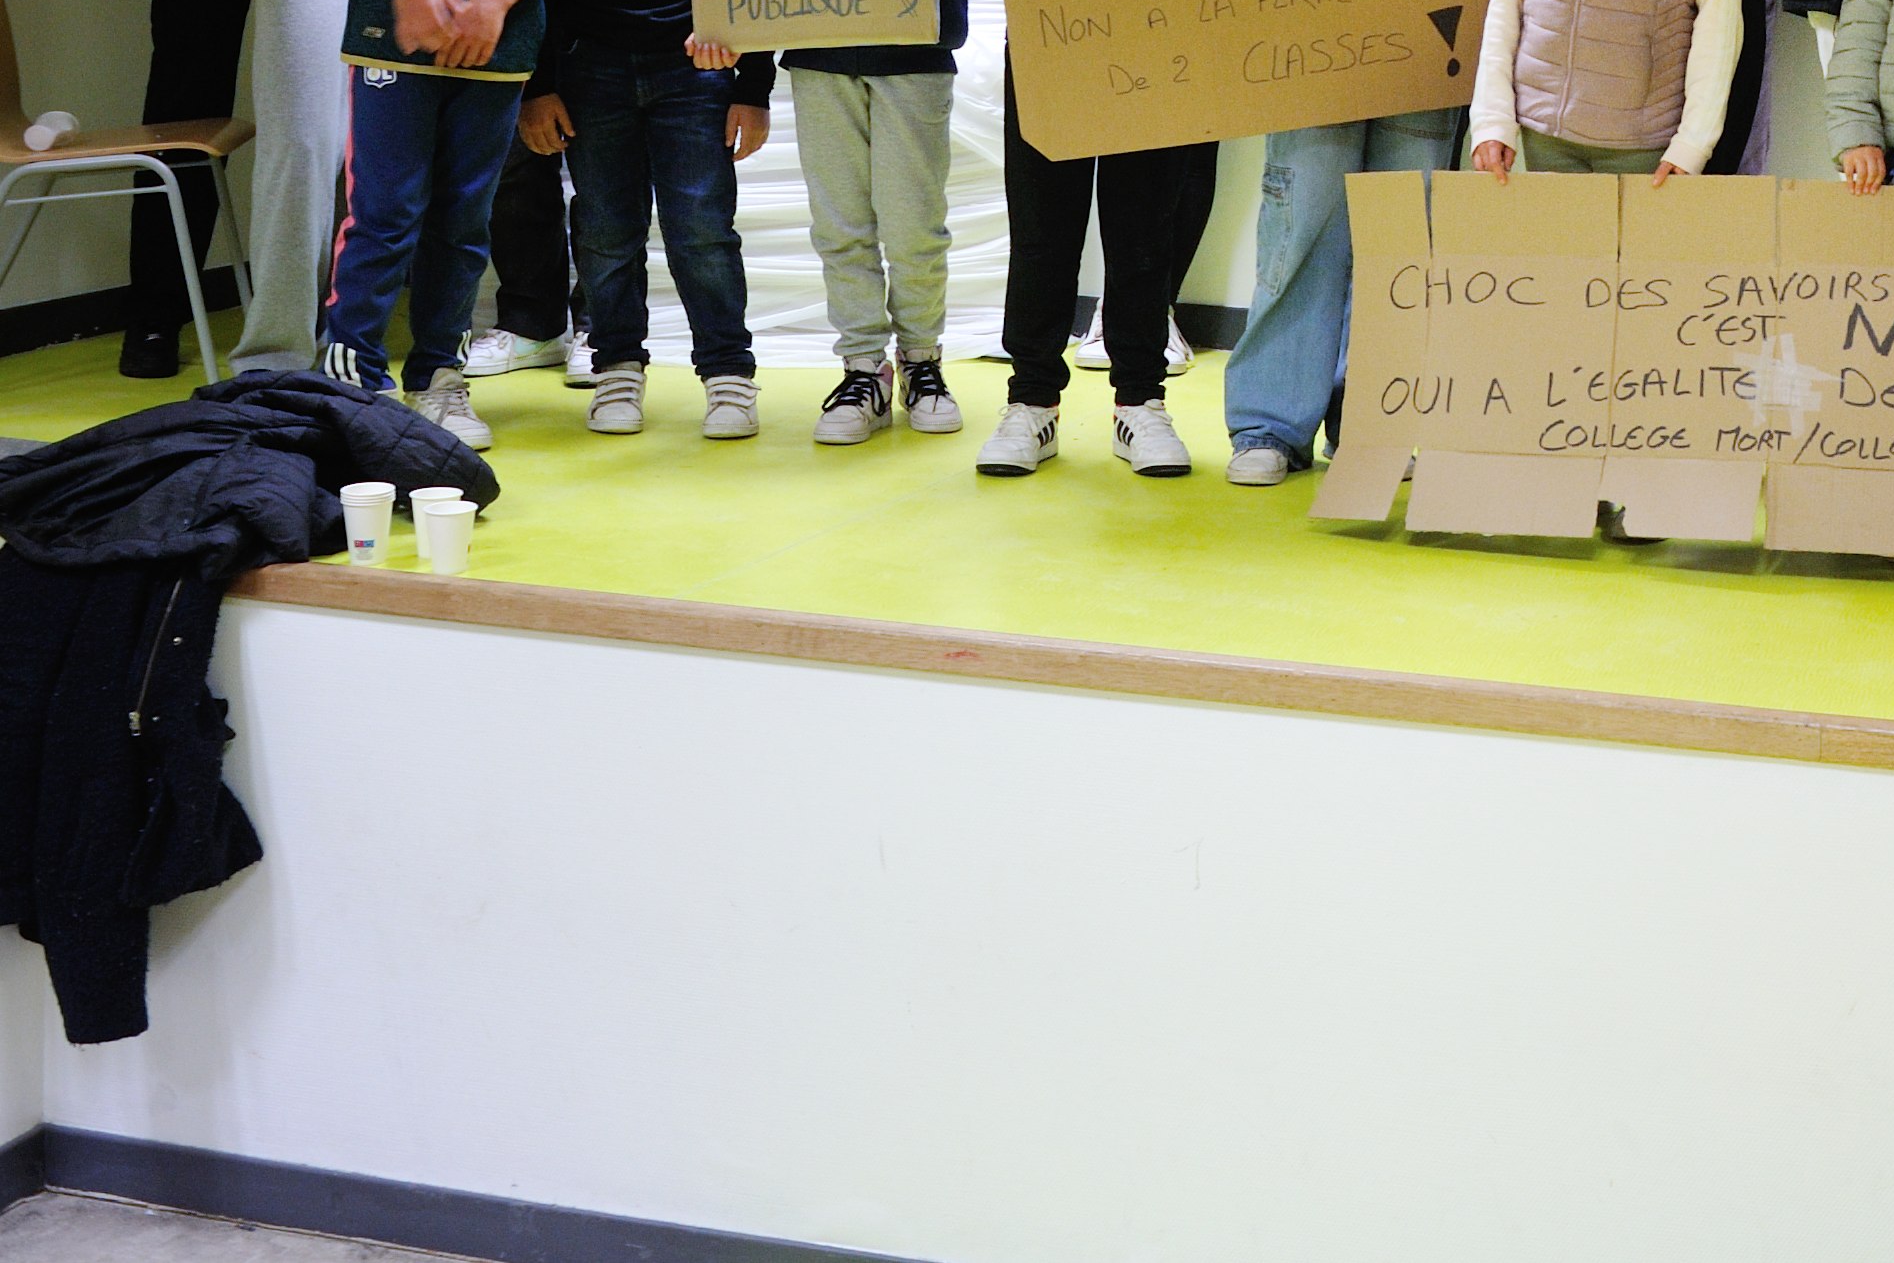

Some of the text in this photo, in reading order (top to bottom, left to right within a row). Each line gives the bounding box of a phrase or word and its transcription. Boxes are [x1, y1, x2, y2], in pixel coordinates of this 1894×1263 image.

[1173, 54, 1190, 85] 2
[1242, 32, 1415, 84] CLASSES
[1389, 265, 1891, 311] CHOC DES SAVOIRS
[1676, 313, 1786, 347] C'EST
[1380, 375, 1454, 416] OUI
[1483, 378, 1512, 415] A
[1538, 419, 1691, 452] COLLEGE
